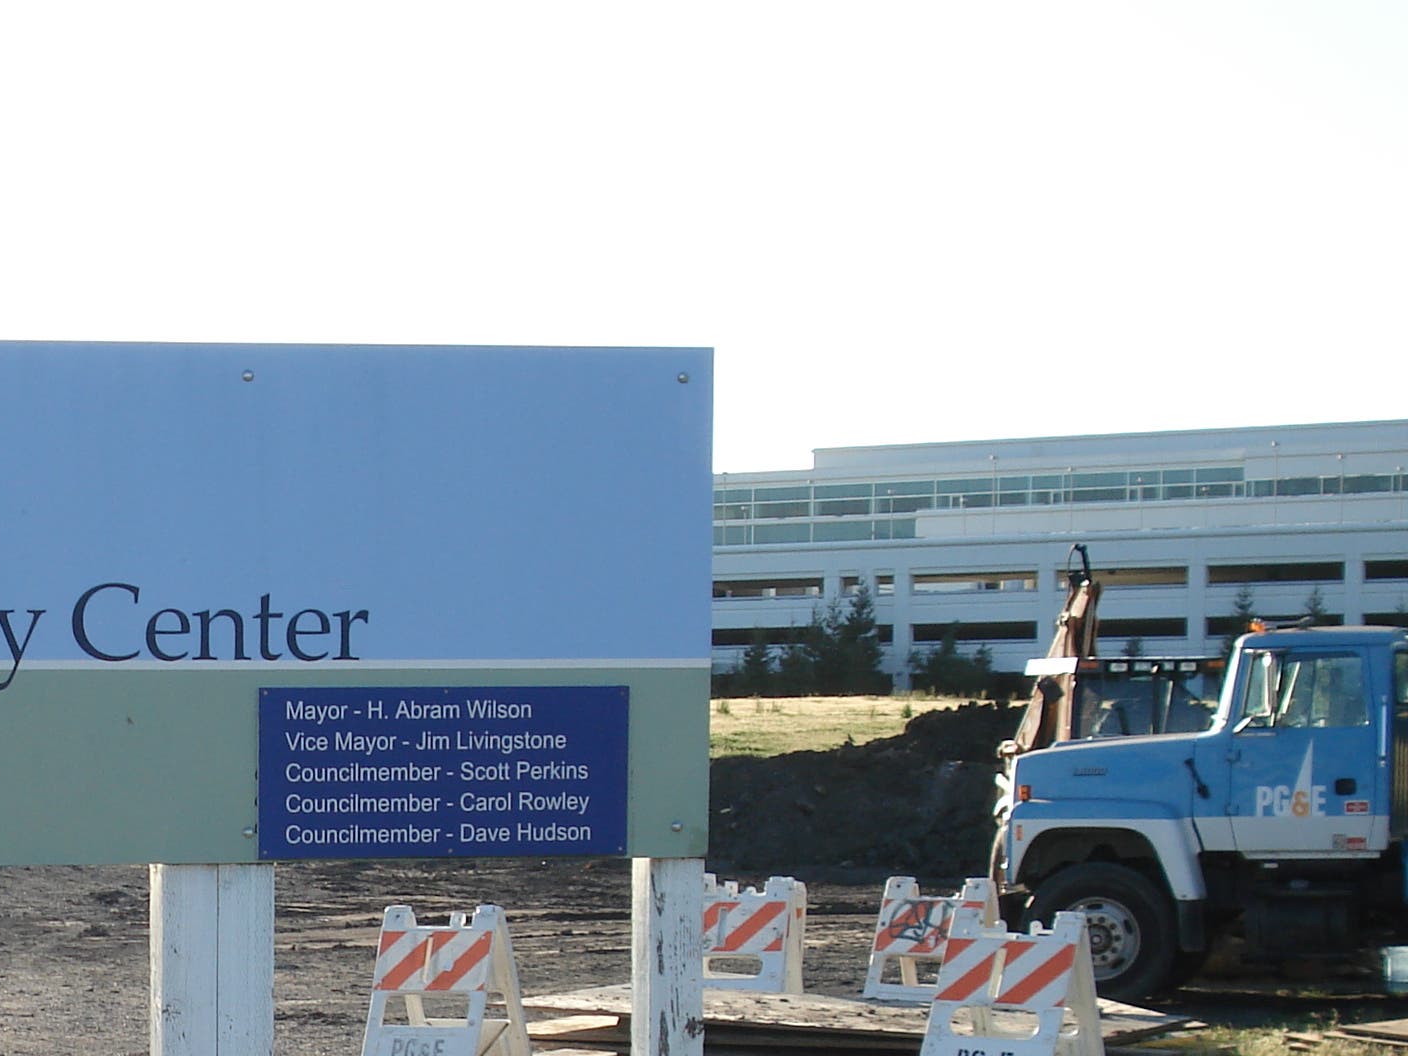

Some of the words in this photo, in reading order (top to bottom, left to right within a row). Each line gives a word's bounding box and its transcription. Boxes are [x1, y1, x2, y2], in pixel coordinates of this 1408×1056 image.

[71, 582, 370, 662] Center
[286, 700, 348, 725] Mayor
[367, 700, 389, 720] H.
[395, 700, 460, 720] Abram
[466, 699, 532, 719] Wilson
[285, 732, 329, 751] Vice
[335, 731, 397, 756] Mayor
[415, 731, 450, 751] Jim
[456, 730, 567, 754] Livingstone
[285, 762, 442, 783] Councilmember
[460, 761, 510, 781] Scott
[516, 760, 589, 780] Perkins
[285, 793, 441, 813] Councilmember
[460, 792, 512, 812] Carol
[519, 791, 590, 815] Rowley
[1255, 784, 1327, 817] PG&E
[285, 823, 441, 844] Councilmember
[460, 823, 511, 842] Dave
[517, 822, 591, 842] Hudson
